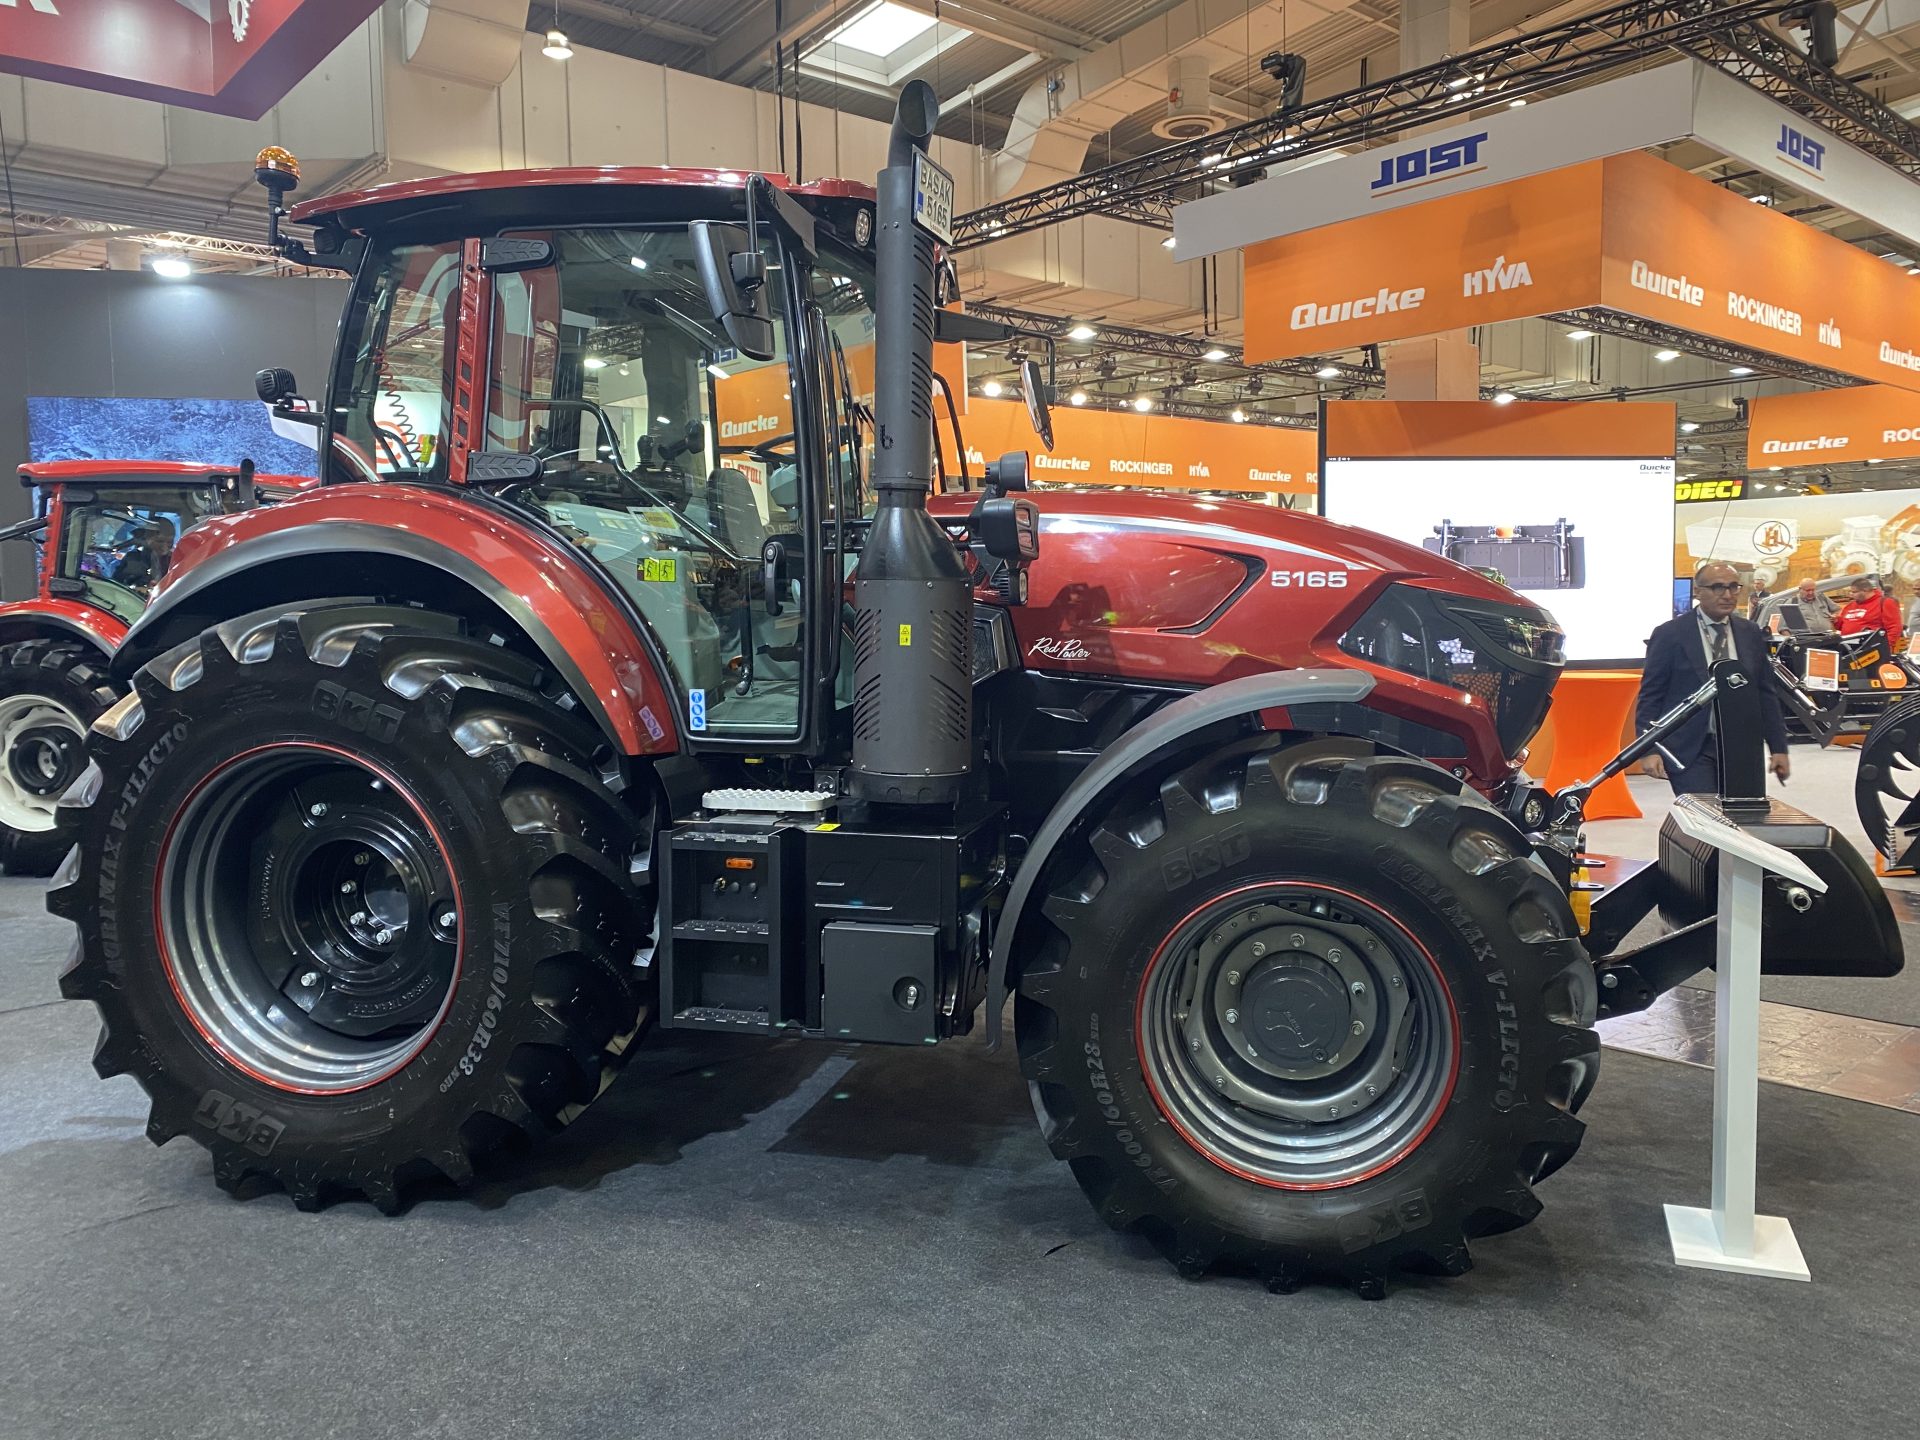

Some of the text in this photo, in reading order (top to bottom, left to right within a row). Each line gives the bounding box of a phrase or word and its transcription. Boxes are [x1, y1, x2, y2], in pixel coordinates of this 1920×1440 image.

[1371, 132, 1488, 190] JOST
[1777, 123, 1825, 171] JOST
[926, 195, 948, 229] 5165
[1290, 255, 1533, 331] Quicke HYVA
[1631, 260, 1704, 306] Quicke
[1728, 291, 1802, 336] ROCKINGER
[1818, 318, 1841, 349] HYVA
[721, 415, 779, 439] Quicke
[1762, 436, 1848, 454] Quicke
[1035, 454, 1090, 471] Quicke
[1110, 459, 1173, 475] ROCKINGER
[1189, 461, 1210, 478] HYVA
[1249, 468, 1292, 482] Quicke
[1271, 570, 1348, 588] 5165
[1028, 637, 1091, 659] Red Power
[312, 680, 406, 745] BKT
